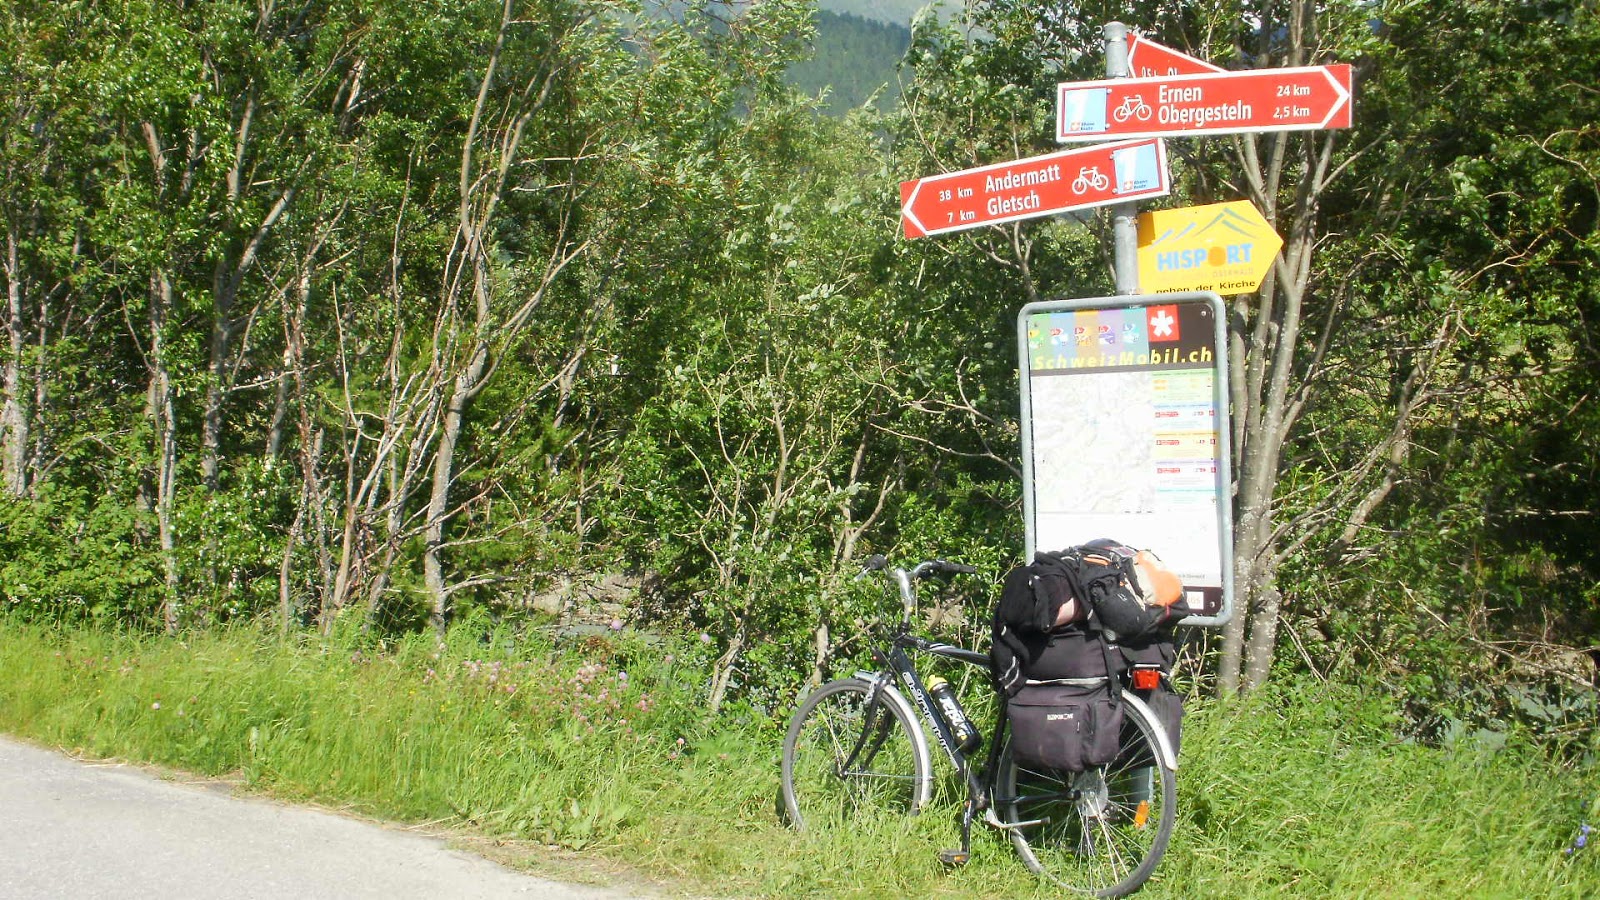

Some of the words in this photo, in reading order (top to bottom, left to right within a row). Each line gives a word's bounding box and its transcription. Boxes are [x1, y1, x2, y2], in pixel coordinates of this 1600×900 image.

[1158, 84, 1202, 104] Ernen
[1276, 85, 1291, 97] 24
[1293, 84, 1311, 96] km
[1158, 100, 1252, 126] Obergesteln
[1273, 106, 1290, 119] 2,5
[1293, 106, 1310, 118] km
[939, 189, 951, 202] 38
[957, 187, 973, 199] km
[985, 164, 1060, 194] Andermatt
[947, 212, 954, 223] 7
[960, 209, 975, 222] km
[987, 194, 1040, 217] Gletsch
[1157, 242, 1253, 272] HISPORT
[1195, 283, 1214, 292] der
[1219, 279, 1256, 290] Kirche
[1034, 346, 1213, 370] SchweizMobil.ch
